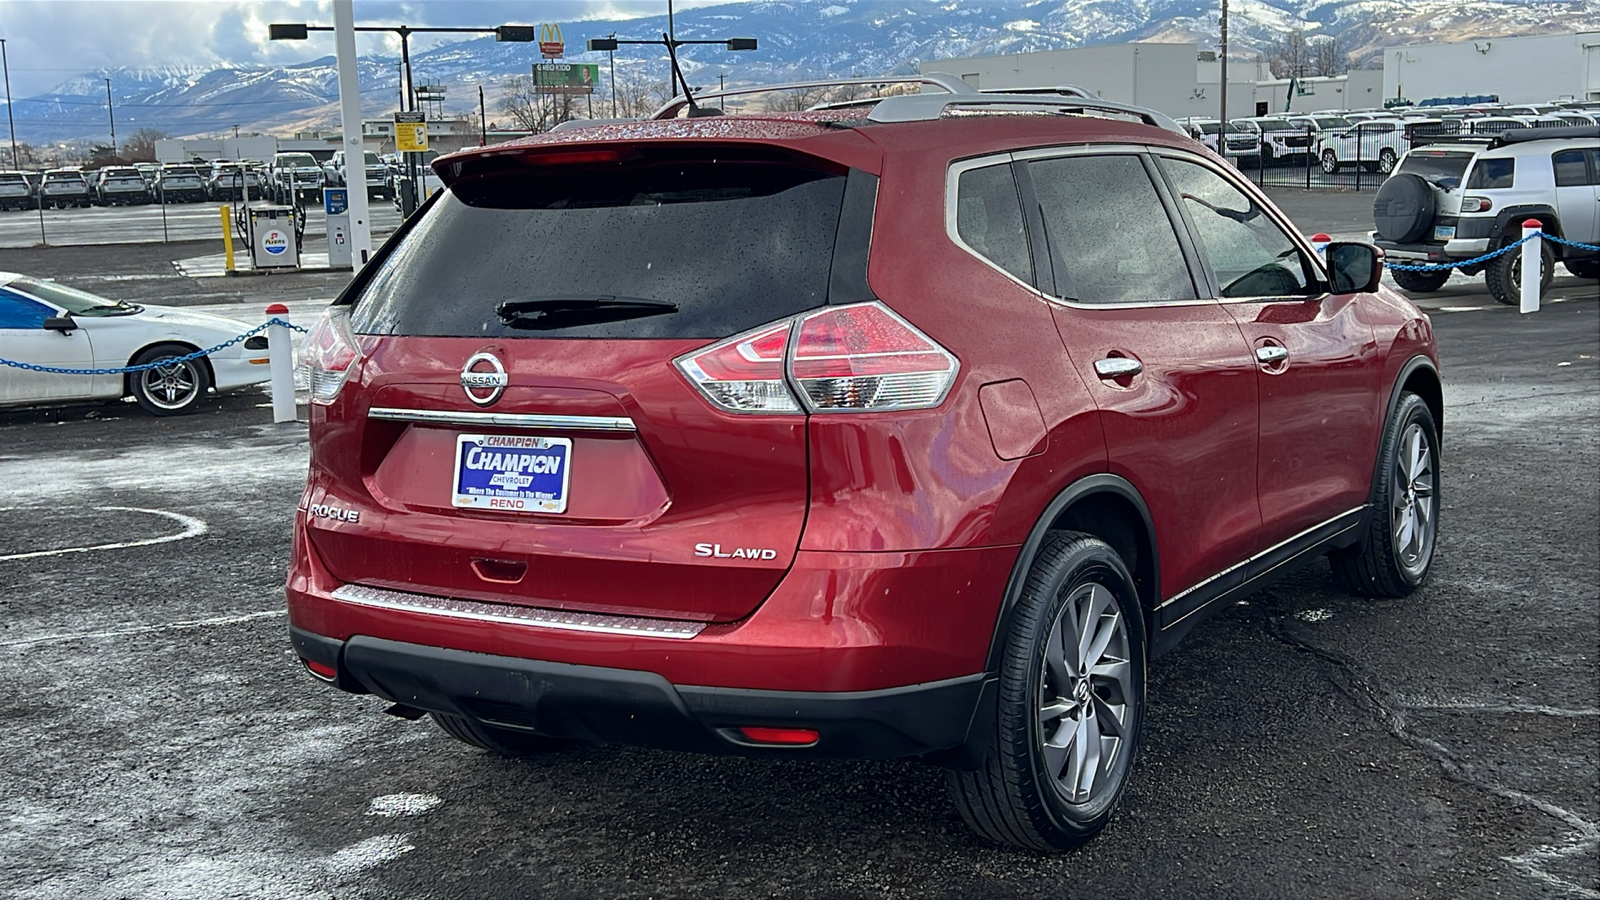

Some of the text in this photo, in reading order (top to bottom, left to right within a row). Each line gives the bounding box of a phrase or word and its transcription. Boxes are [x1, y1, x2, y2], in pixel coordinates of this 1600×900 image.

[461, 376, 500, 384] NISSAN
[487, 436, 540, 448] CHAMPION
[466, 447, 561, 474] CHAMPION
[492, 475, 530, 485] CHEVROLET
[490, 498, 524, 509] RENO
[311, 503, 359, 523] ROGUE
